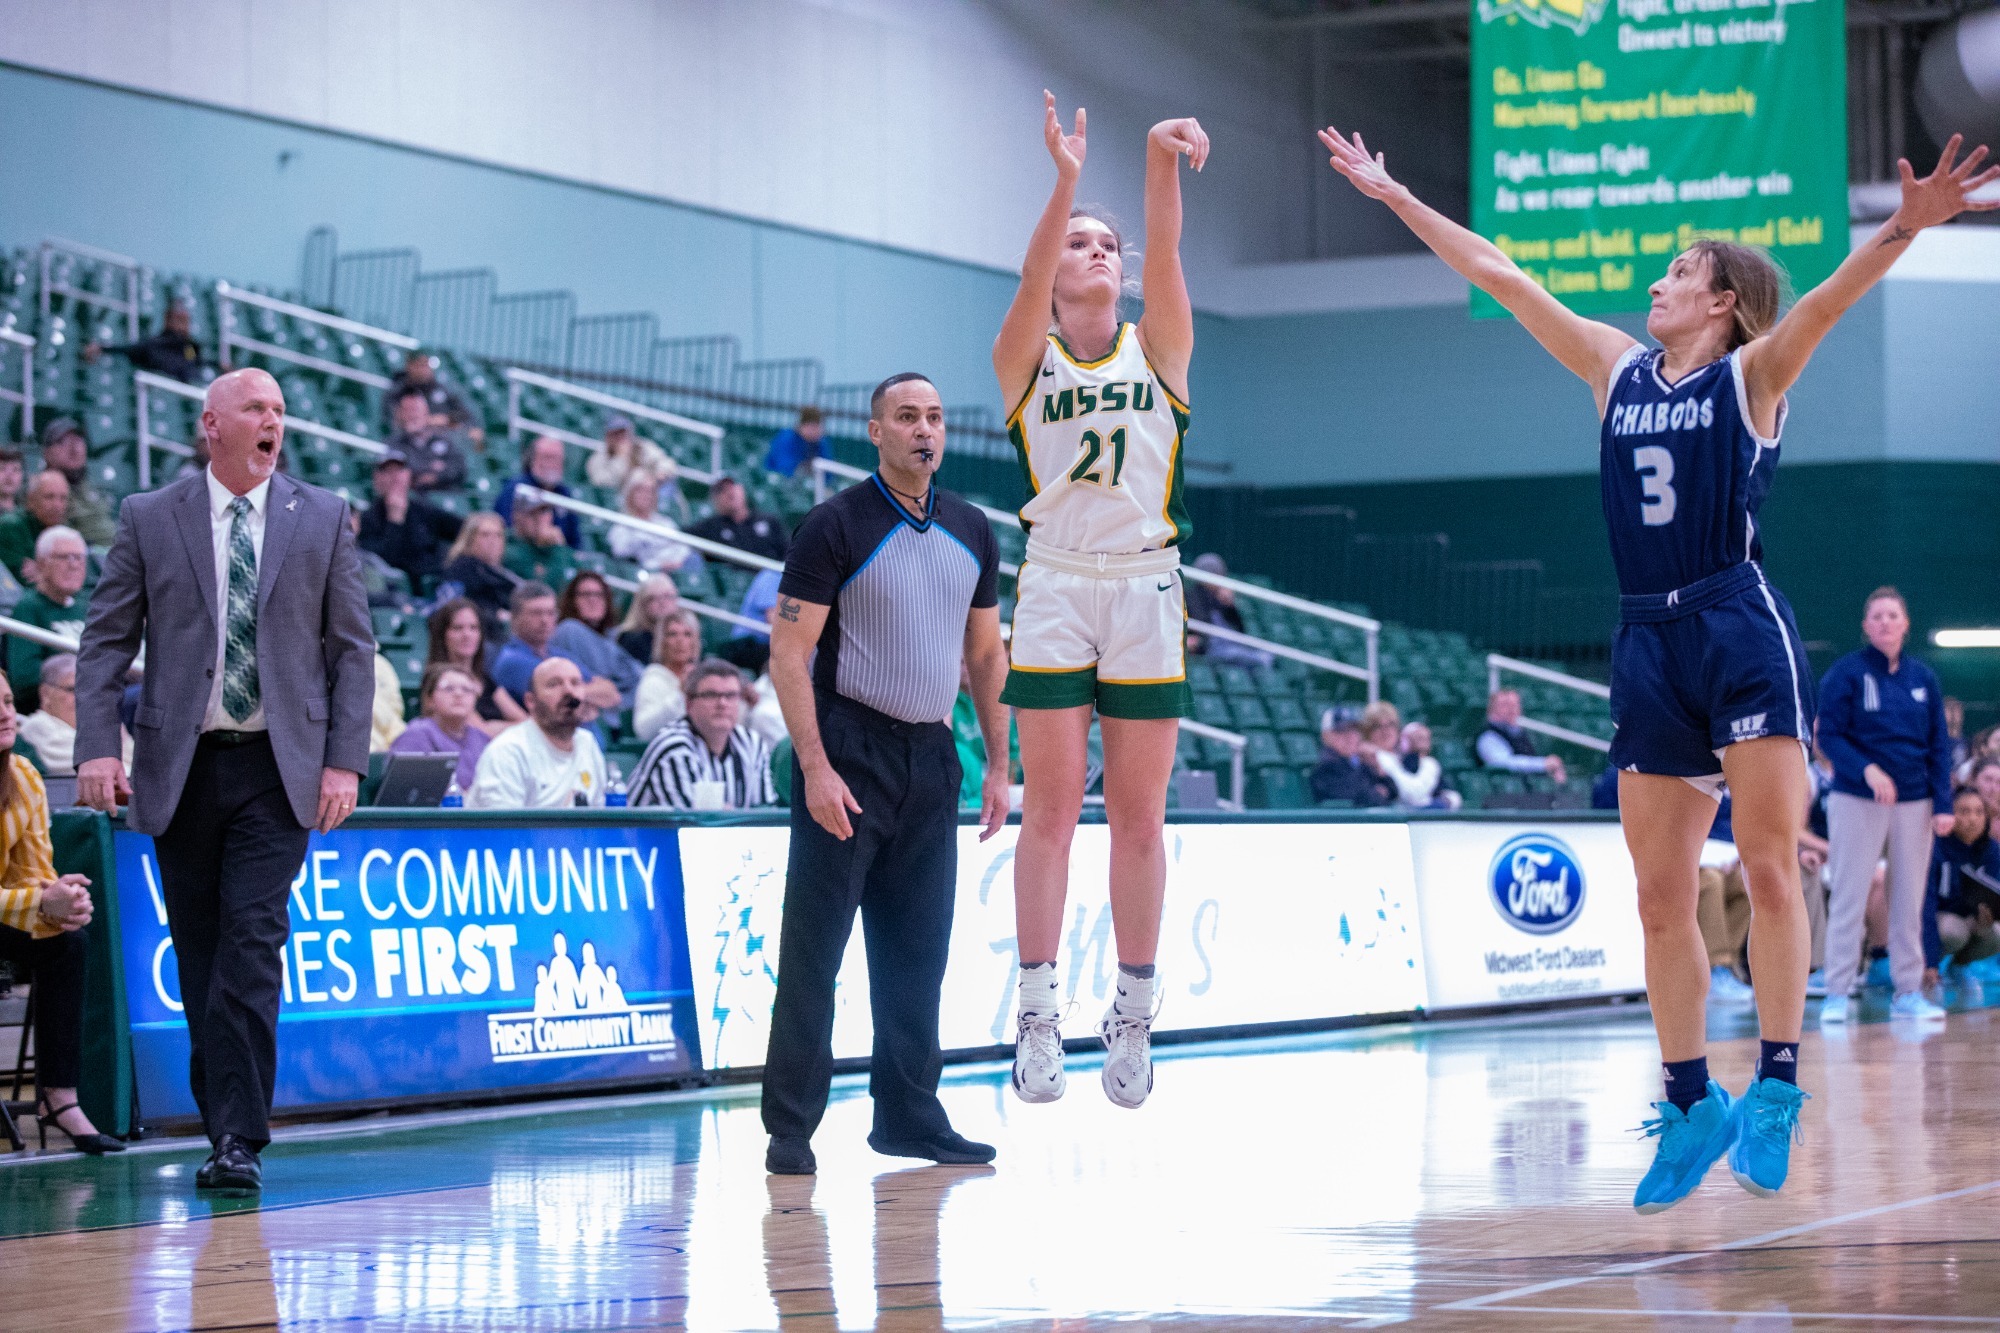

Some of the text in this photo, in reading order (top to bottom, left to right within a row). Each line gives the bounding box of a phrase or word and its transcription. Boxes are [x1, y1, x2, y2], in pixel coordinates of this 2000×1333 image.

[1618, 18, 1787, 52] Onward to victory
[1525, 66, 1576, 93] Lions
[1494, 85, 1756, 131] Marching forward fearlessly
[1548, 148, 1598, 176] Lions
[1495, 169, 1792, 212] As we roar towards another win
[1553, 230, 1587, 259] and
[1777, 216, 1822, 246] Gold
[1547, 267, 1598, 293] Lions
[1041, 380, 1156, 425] MSSU
[1067, 425, 1129, 490] 21
[1633, 446, 1677, 526] 3
[359, 847, 659, 921] COMMUNITY
[1508, 848, 1571, 917] Ford
[370, 923, 518, 999] FIRST
[1535, 947, 1563, 971] Ford
[488, 1011, 676, 1056] FIRST COMMUNITY BANK
